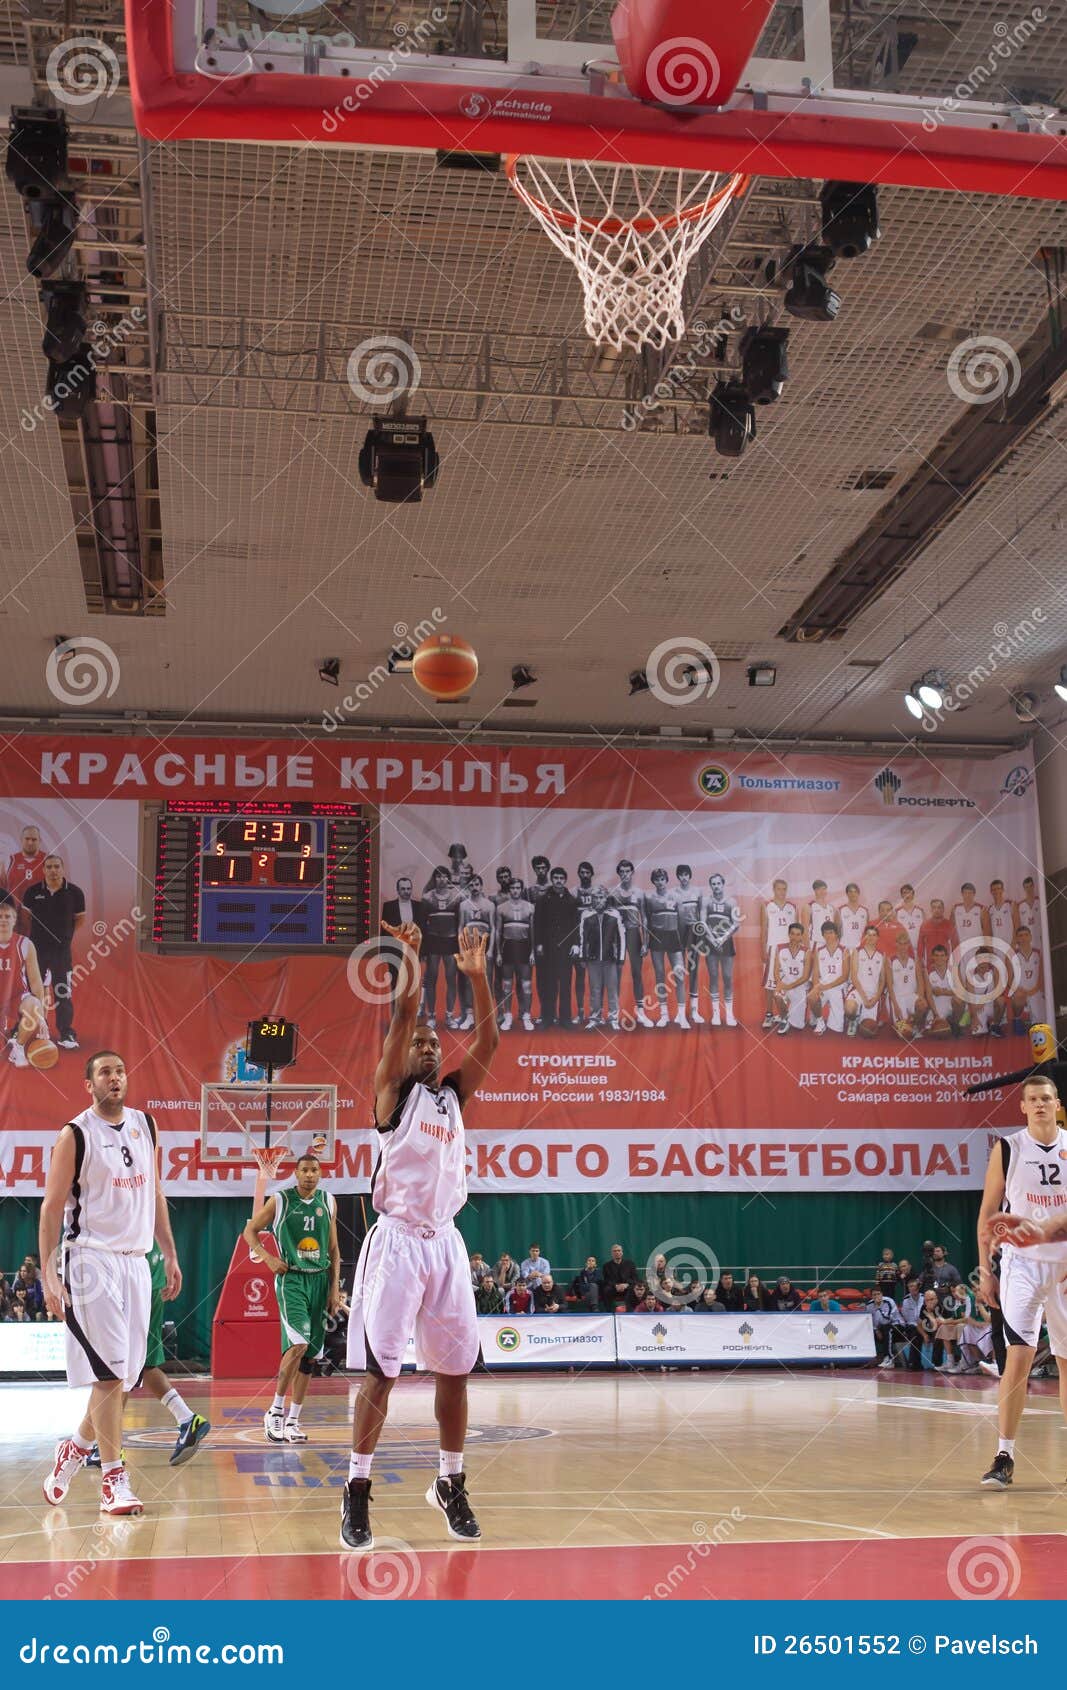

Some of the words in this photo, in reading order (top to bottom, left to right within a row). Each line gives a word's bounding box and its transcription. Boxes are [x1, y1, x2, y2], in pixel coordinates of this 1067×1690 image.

[40, 752, 315, 789] КРАСНЫЕ
[340, 757, 567, 795] КРЫЛЬЯ
[737, 774, 841, 792] Тольяттиазот
[898, 796, 976, 809] РОСНЕФТЬ
[244, 821, 300, 842] 2:31
[260, 1023, 286, 1037] 2:31
[517, 1054, 617, 1068] СТРОИТЕЛЬ
[842, 1056, 920, 1068] КРАСНЫЕ
[924, 1056, 993, 1068] КРЫЛЬЯ
[532, 1072, 608, 1087] Куйбышев
[799, 1073, 957, 1087] ДЕТСКО-ЮНОШЕСКАЯ
[474, 1089, 538, 1102] Чемпион
[542, 1090, 594, 1102] России
[598, 1090, 666, 1103] 1983/1984
[837, 1090, 890, 1103] Самара
[894, 1093, 931, 1102] сезон
[147, 1100, 236, 1111] ПРАВИТЕЛСТВО
[120, 1145, 133, 1168] 8
[628, 1143, 971, 1177] БАСКЕТБОЛА!
[1038, 1163, 1062, 1186] 12
[303, 1215, 315, 1231] 21
[527, 1333, 604, 1345] Тольяттиазот
